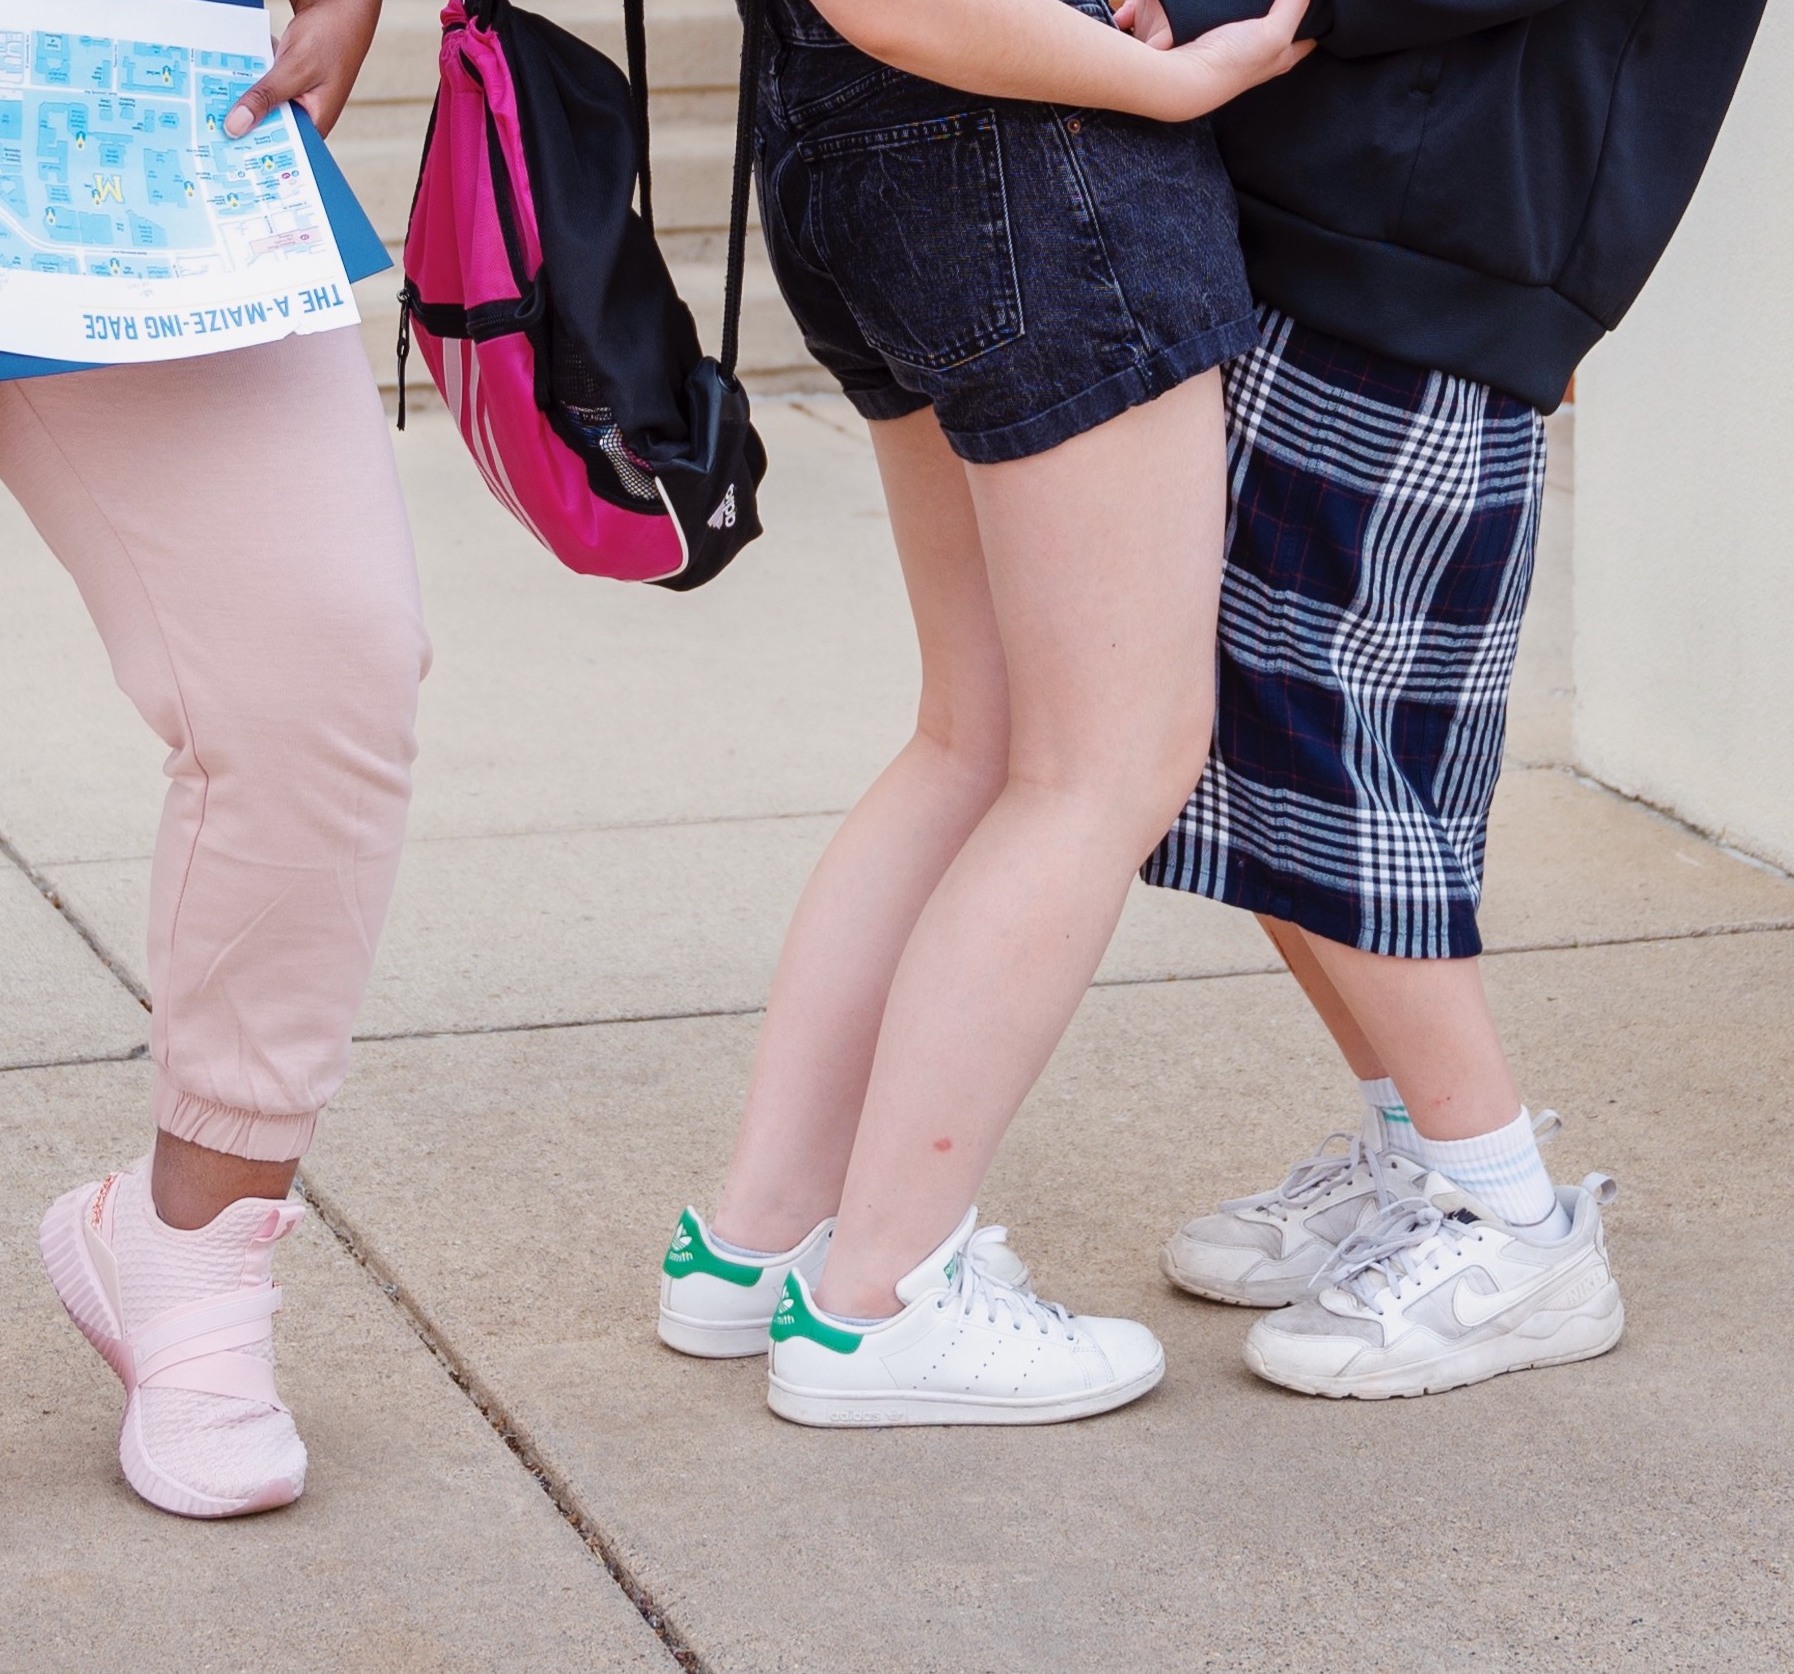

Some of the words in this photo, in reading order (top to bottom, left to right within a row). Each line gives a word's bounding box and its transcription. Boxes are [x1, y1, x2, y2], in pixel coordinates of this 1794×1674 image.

[93, 173, 125, 204] M
[298, 283, 344, 314] THE
[83, 314, 138, 340] RACE
[144, 295, 290, 340] A-MAIZE-ING
